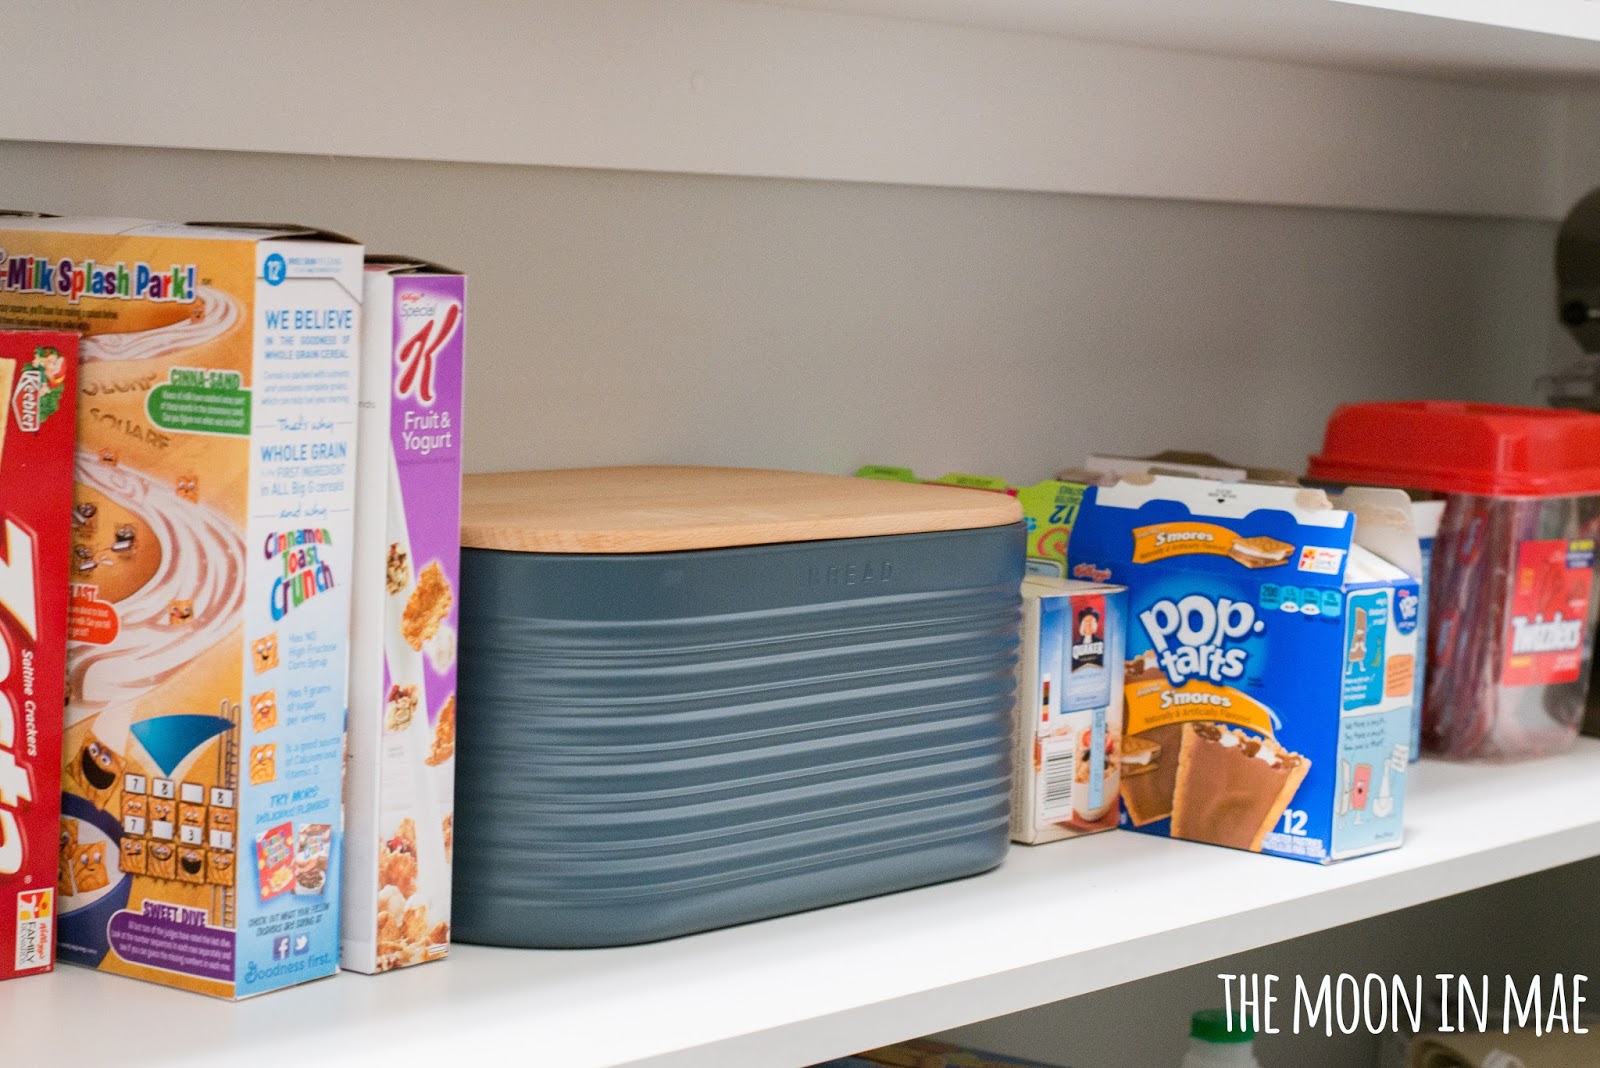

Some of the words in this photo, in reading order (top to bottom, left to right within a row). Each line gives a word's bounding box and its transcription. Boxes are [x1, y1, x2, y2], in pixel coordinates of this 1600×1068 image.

[58, 260, 129, 301] Splash
[136, 264, 195, 299] Park!
[265, 310, 290, 329] WE
[295, 310, 352, 329] BELIEVE
[401, 304, 435, 318] Special
[399, 304, 459, 401] K
[404, 411, 440, 430] Fruit
[441, 411, 452, 428] &
[260, 445, 307, 462] WHOLE
[311, 442, 347, 460] GRAIN
[402, 432, 452, 455] Yogurt
[1049, 504, 1076, 525] 12
[264, 528, 332, 560] Cinnamon
[1155, 531, 1214, 546] S'mores
[282, 544, 321, 580] Toast
[270, 560, 334, 622] Crunch
[22, 650, 34, 696] Saltine
[1160, 644, 1247, 683] tarts
[1160, 690, 1232, 709] S'mores
[24, 700, 38, 757] Crackers
[1283, 808, 1308, 836] 12
[144, 900, 179, 921] SWEET
[26, 922, 37, 964] FAMILY
